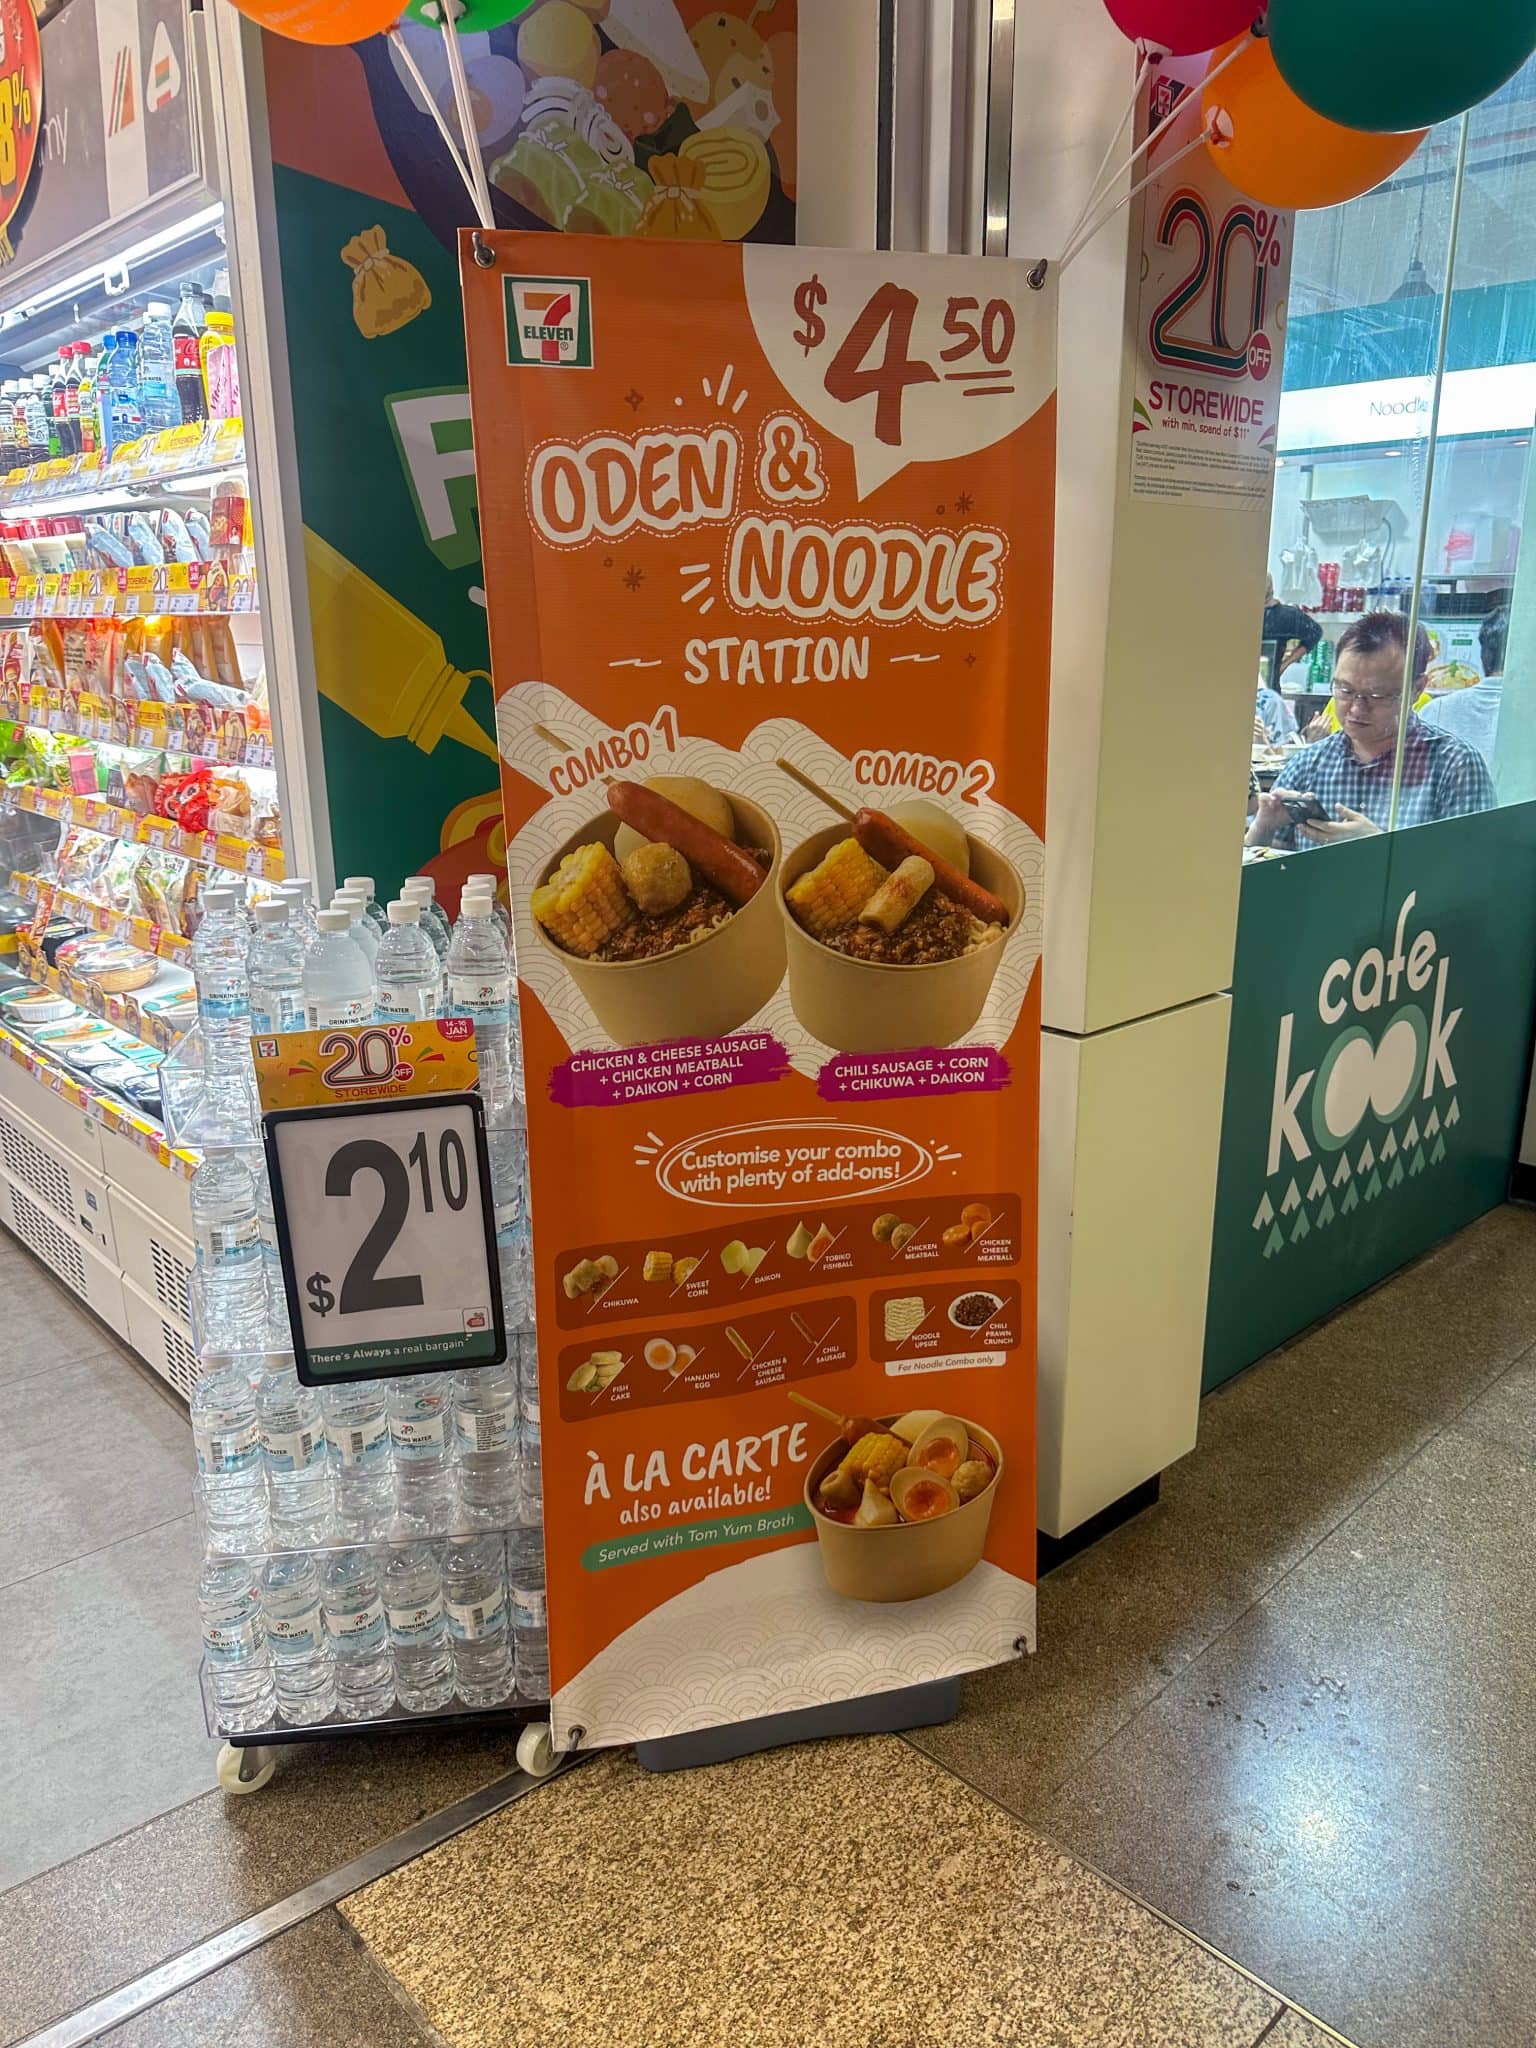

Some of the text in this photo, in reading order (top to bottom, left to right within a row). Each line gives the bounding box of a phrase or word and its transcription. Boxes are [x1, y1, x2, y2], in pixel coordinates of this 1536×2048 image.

[1249, 346, 1271, 369] OFF
[1149, 380, 1264, 426] STOREWIDE
[1162, 416, 1179, 428] with
[1199, 423, 1222, 436] spend
[1223, 427, 1232, 437] of
[536, 420, 821, 538] ODEN &
[733, 522, 998, 618] NOODLE
[684, 636, 870, 685] STATION
[550, 711, 675, 796] COMBO 1
[856, 755, 989, 807] COMBO 2
[390, 1006, 409, 1014] WATER
[328, 1018, 360, 1026] DRINKING
[445, 1026, 468, 1035] JAN
[319, 1025, 413, 1089] 20%
[571, 1038, 768, 1073] CHICKEN & CHEESE SAUSAGE
[394, 1067, 412, 1078] OFF
[599, 1056, 743, 1086] + CHICKEN MEATBALL
[835, 1057, 989, 1078] CHILI SAUSAGE + CORN
[612, 1072, 733, 1099] + DAIKON + CORN
[839, 1071, 984, 1092] + CHIKUWA + DAIKON
[335, 1084, 407, 1099] STOREWIDE
[681, 1139, 902, 1171] Customise your combo
[680, 1161, 901, 1194] with plenty of add-ons!
[907, 1243, 937, 1252] CHICKEN
[825, 1253, 851, 1262] TOBIKO
[905, 1251, 939, 1260] MEATBALL
[977, 1254, 1014, 1262] MEATBALL
[823, 1261, 853, 1270] FISHBALL
[755, 1273, 781, 1284] DAIKON
[686, 1280, 710, 1291] SWEET
[687, 1289, 709, 1298] CORN
[603, 1298, 639, 1308] CHIKUWA
[912, 1332, 940, 1341] NOODLE
[822, 1345, 839, 1355] CHILI
[915, 1340, 938, 1348] UPSIZE
[310, 1352, 351, 1364] There's
[353, 1346, 391, 1359] Always
[402, 1344, 423, 1354] real
[816, 1352, 846, 1364] SAUSAGE
[752, 1358, 781, 1371] CHICKEN
[898, 1355, 994, 1372] For Noodle Combo only
[684, 1372, 720, 1383] HANJUKU
[757, 1366, 782, 1378] CHEESE
[695, 1381, 710, 1389] EGG
[755, 1373, 786, 1387] SAUSAGE
[612, 1384, 629, 1393] FISH
[610, 1392, 631, 1402] CAKE
[584, 1422, 808, 1505] À LA CARTE
[619, 1475, 772, 1525] also available!
[598, 1513, 795, 1563] Served with Tom Yum Broth
